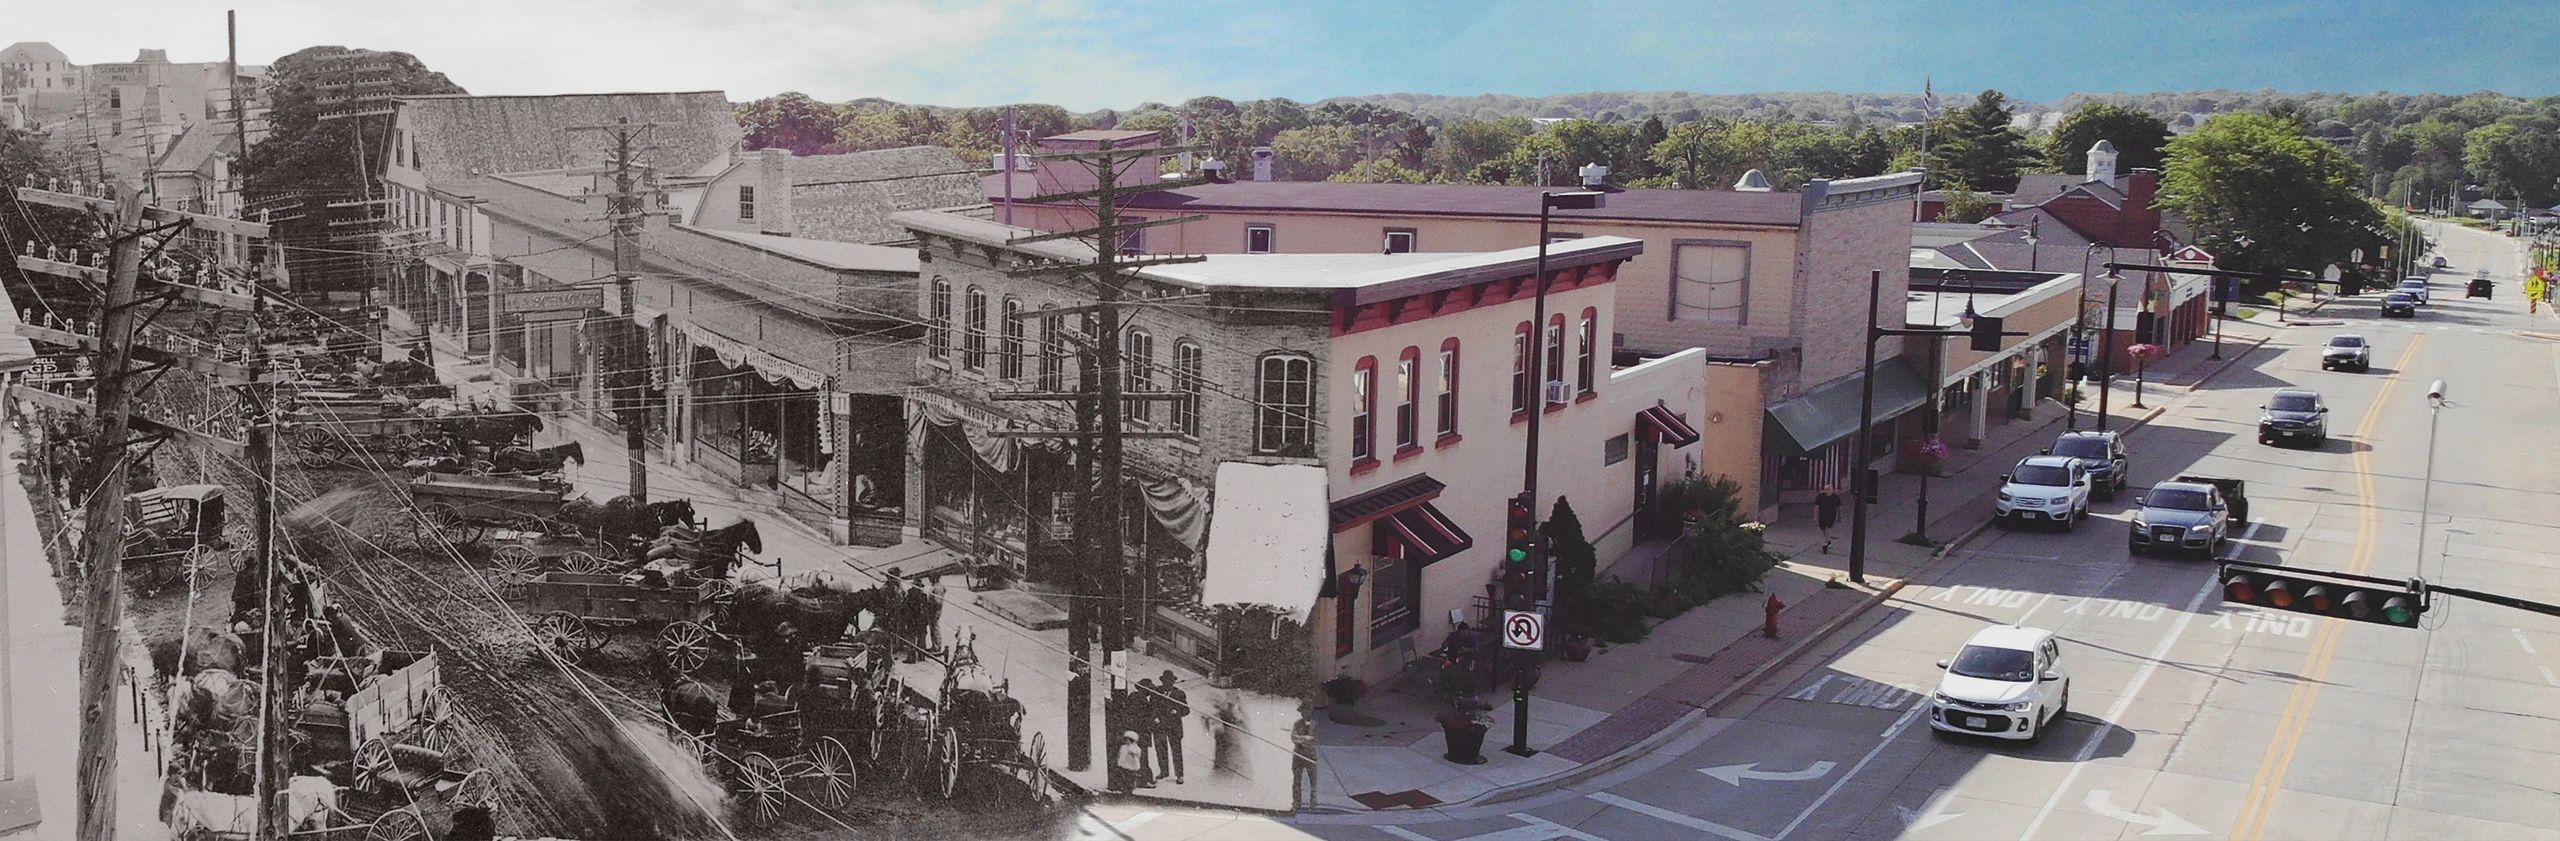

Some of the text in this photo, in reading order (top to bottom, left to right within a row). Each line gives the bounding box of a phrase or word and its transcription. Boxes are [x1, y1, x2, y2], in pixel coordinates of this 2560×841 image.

[1931, 585, 2031, 608] ONLY
[2064, 597, 2169, 622] ONLY
[2210, 611, 2313, 638] ONLY
[1786, 673, 1920, 710] ONLY
